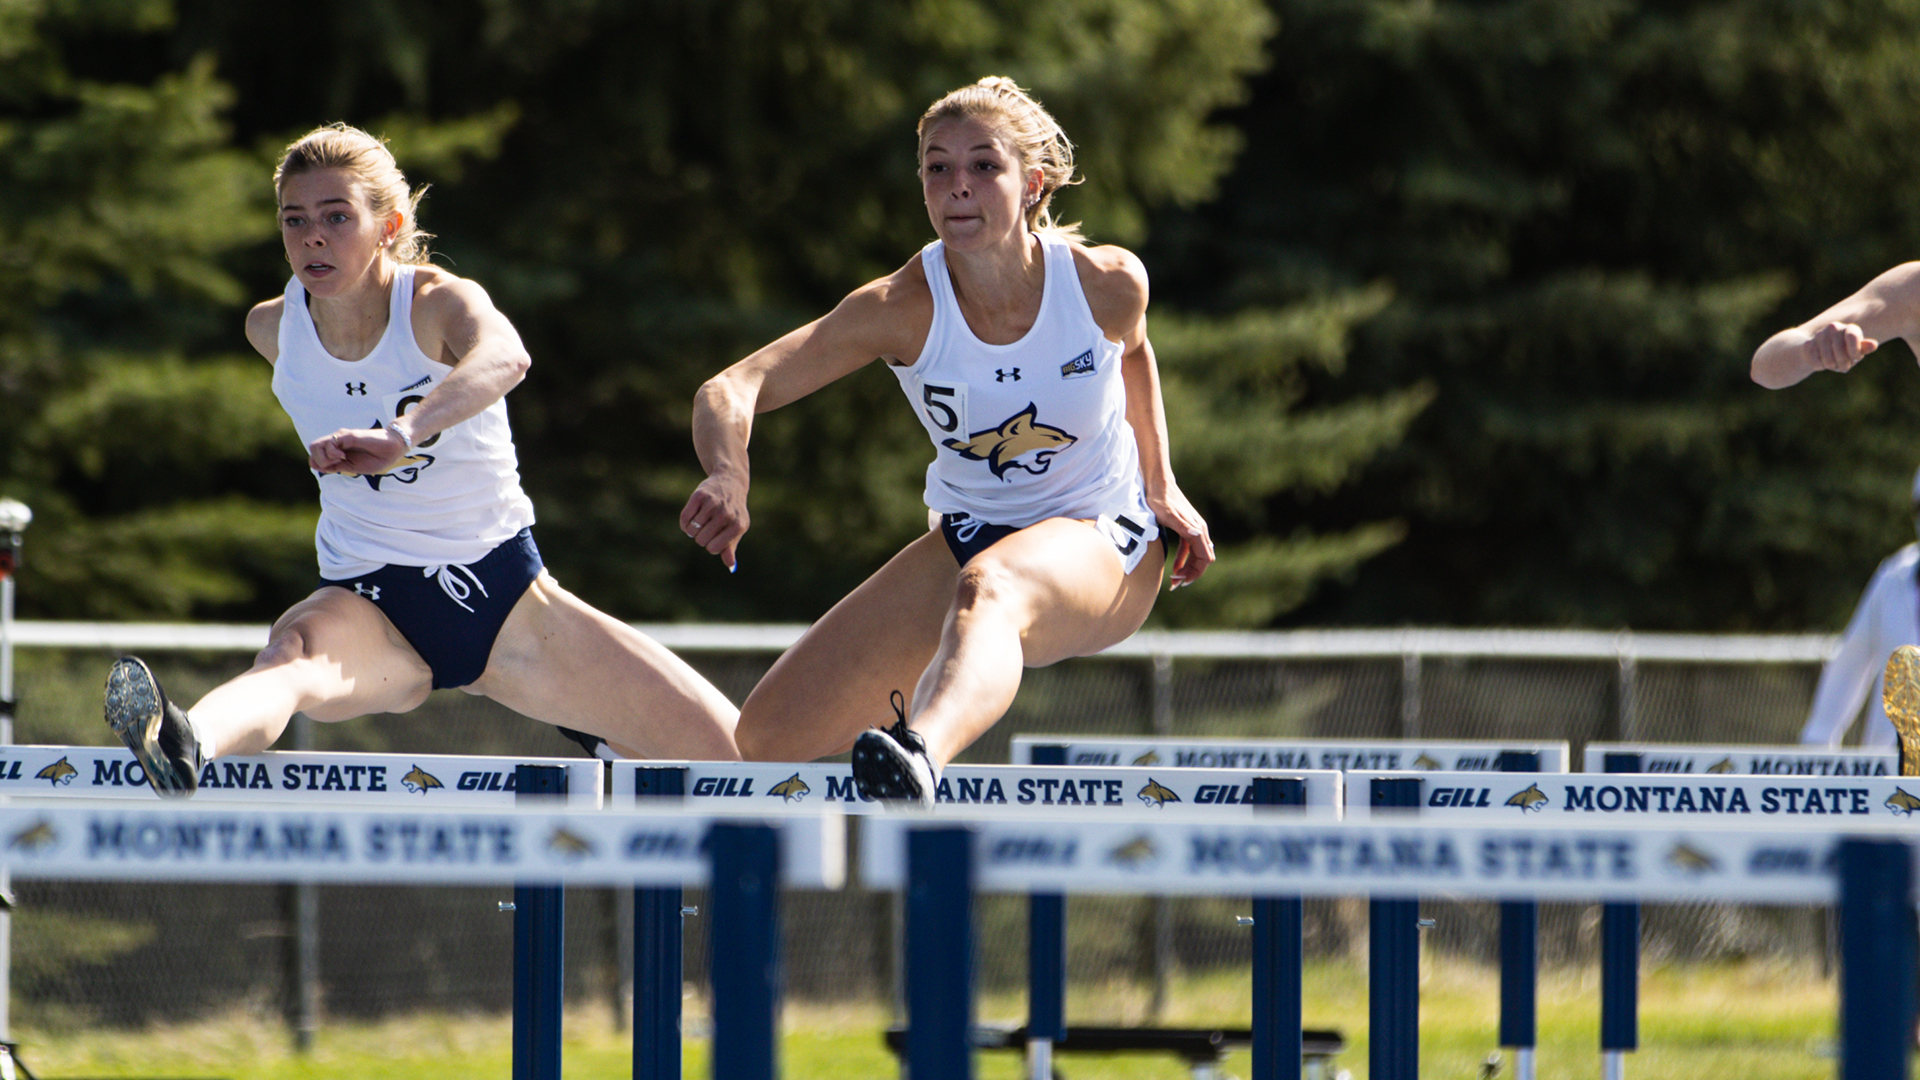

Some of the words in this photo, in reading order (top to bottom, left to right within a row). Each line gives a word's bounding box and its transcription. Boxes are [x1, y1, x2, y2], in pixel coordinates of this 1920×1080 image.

[924, 383, 958, 433] 5
[1175, 752, 1311, 769] MONTANA
[1320, 754, 1402, 770] STATE
[1750, 758, 1888, 776] MONTANA
[92, 760, 272, 789] MOANA
[282, 764, 387, 791] STATE
[693, 778, 754, 797] GILL
[1017, 779, 1123, 806] STATE
[1429, 788, 1491, 807] GILL
[1563, 785, 1751, 813] MONTANA
[1761, 788, 1869, 814] STATE
